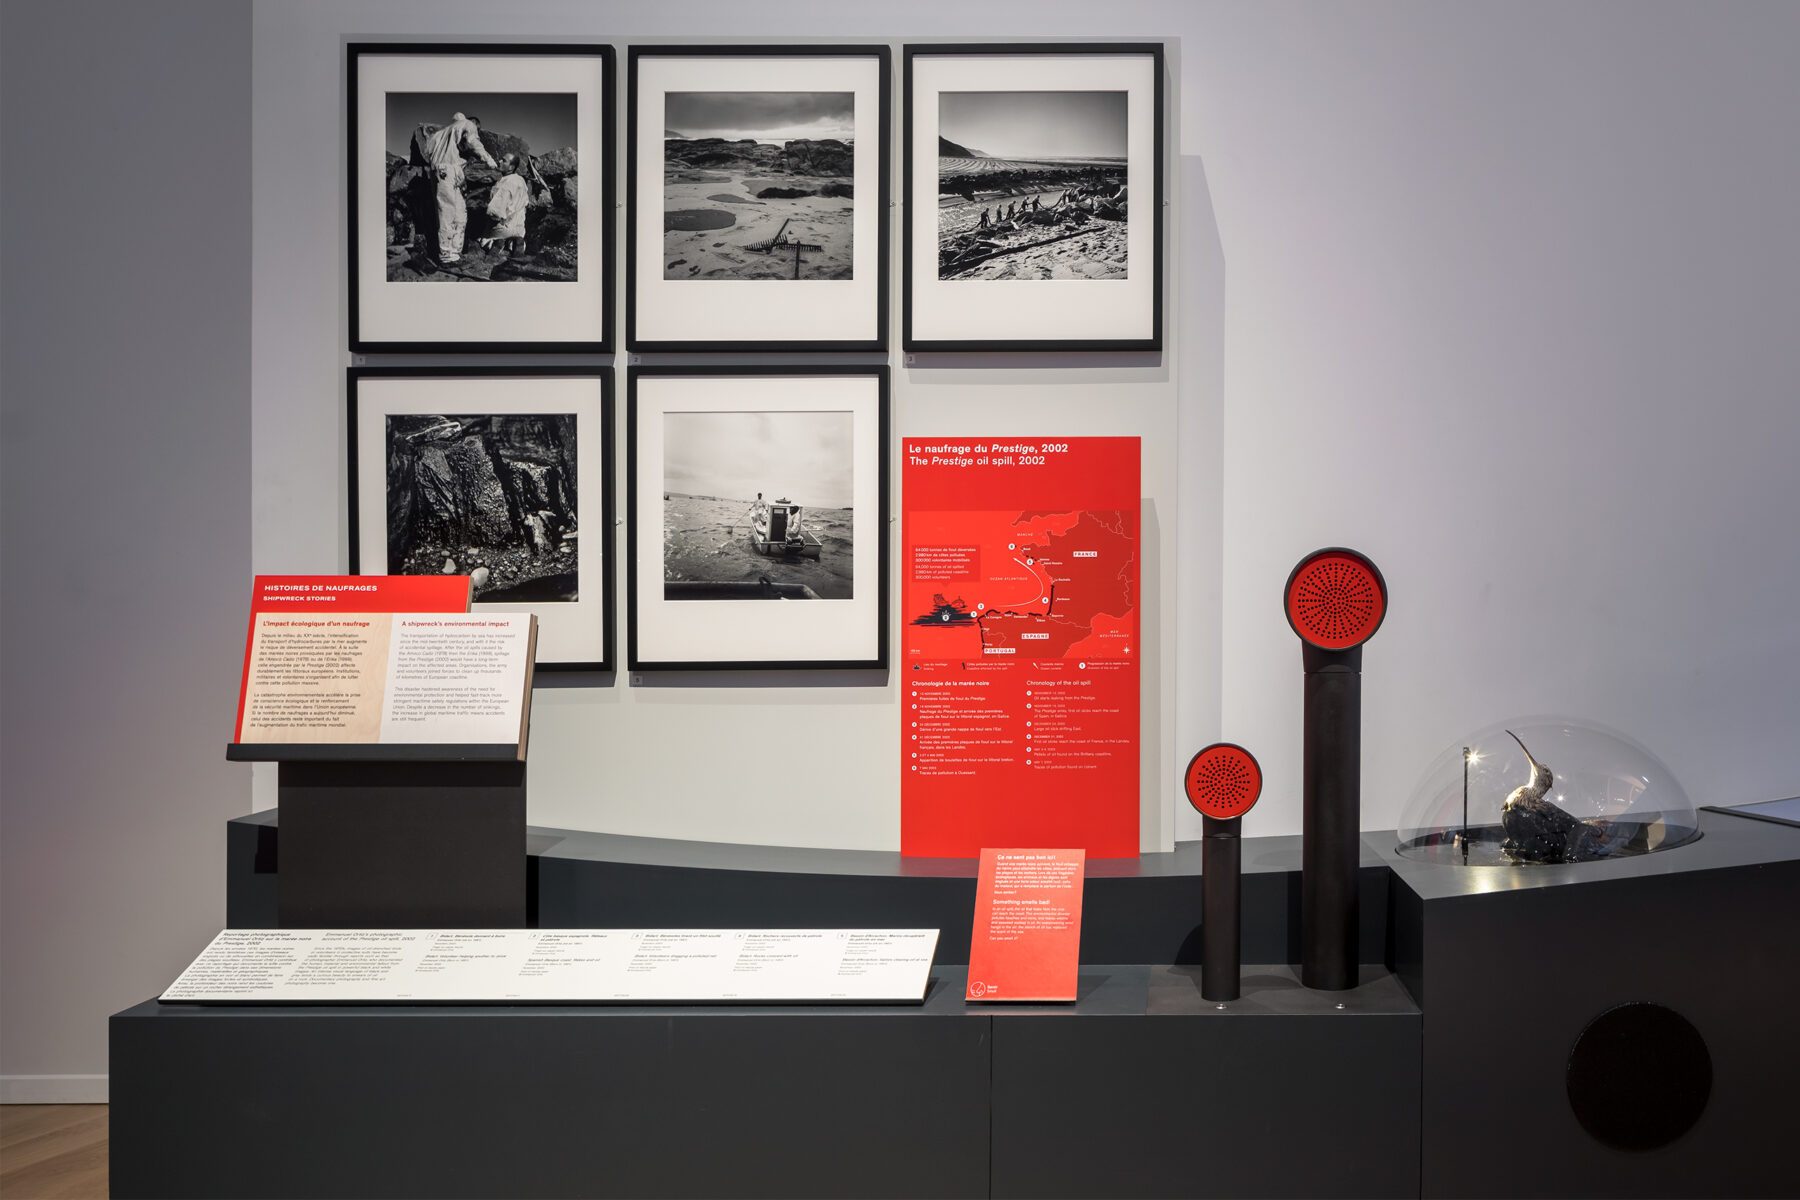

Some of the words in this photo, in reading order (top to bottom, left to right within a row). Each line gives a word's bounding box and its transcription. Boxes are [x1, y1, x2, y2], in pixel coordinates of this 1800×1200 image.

[909, 444, 920, 452] Le
[925, 444, 970, 454] naufrage
[974, 444, 987, 452] du
[991, 444, 1037, 454] Prestige,
[1042, 444, 1068, 452] 2002
[910, 457, 927, 465] The
[932, 457, 972, 466] Prestige
[977, 457, 988, 465] oil
[992, 457, 1015, 466] spill,
[1019, 456, 1045, 464] 2002
